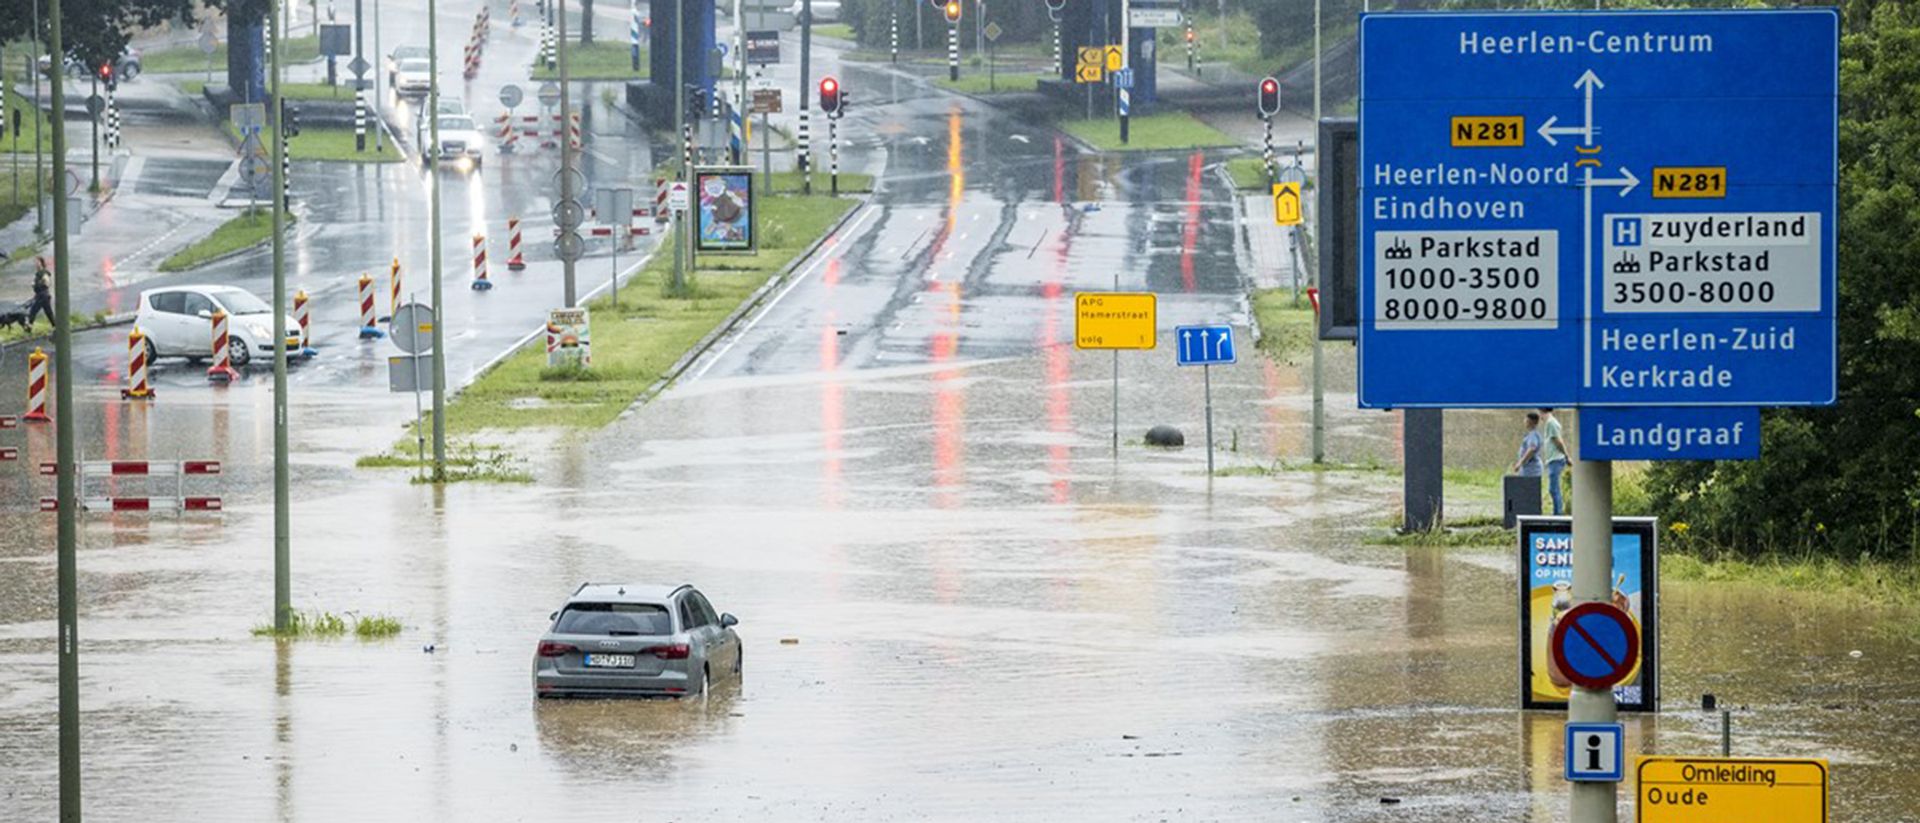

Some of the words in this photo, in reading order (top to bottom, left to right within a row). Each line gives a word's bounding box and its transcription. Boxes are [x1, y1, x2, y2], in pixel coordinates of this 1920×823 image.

[1459, 31, 1713, 54] Heerlen-Centrum
[1374, 162, 1570, 186] Heerlen-Noord
[1374, 196, 1525, 220] Eindhoven
[1651, 216, 1806, 244] zuyderland
[1420, 236, 1541, 259] Parkstad
[1649, 250, 1770, 272] Parkstad
[1384, 267, 1541, 290] 1000-3500
[1614, 281, 1775, 304] 3500-8000
[1081, 311, 1148, 319] Hamerstraat
[1384, 297, 1547, 320] 8000-9800
[1081, 336, 1103, 344] volg
[1602, 327, 1796, 351] Heerlen-Zuid
[1602, 365, 1733, 388] Kerkrade
[1597, 422, 1744, 451] Landgraaf
[1535, 568, 1550, 578] OP
[1682, 764, 1776, 788] Omleiding
[1648, 787, 1708, 805] Oude
